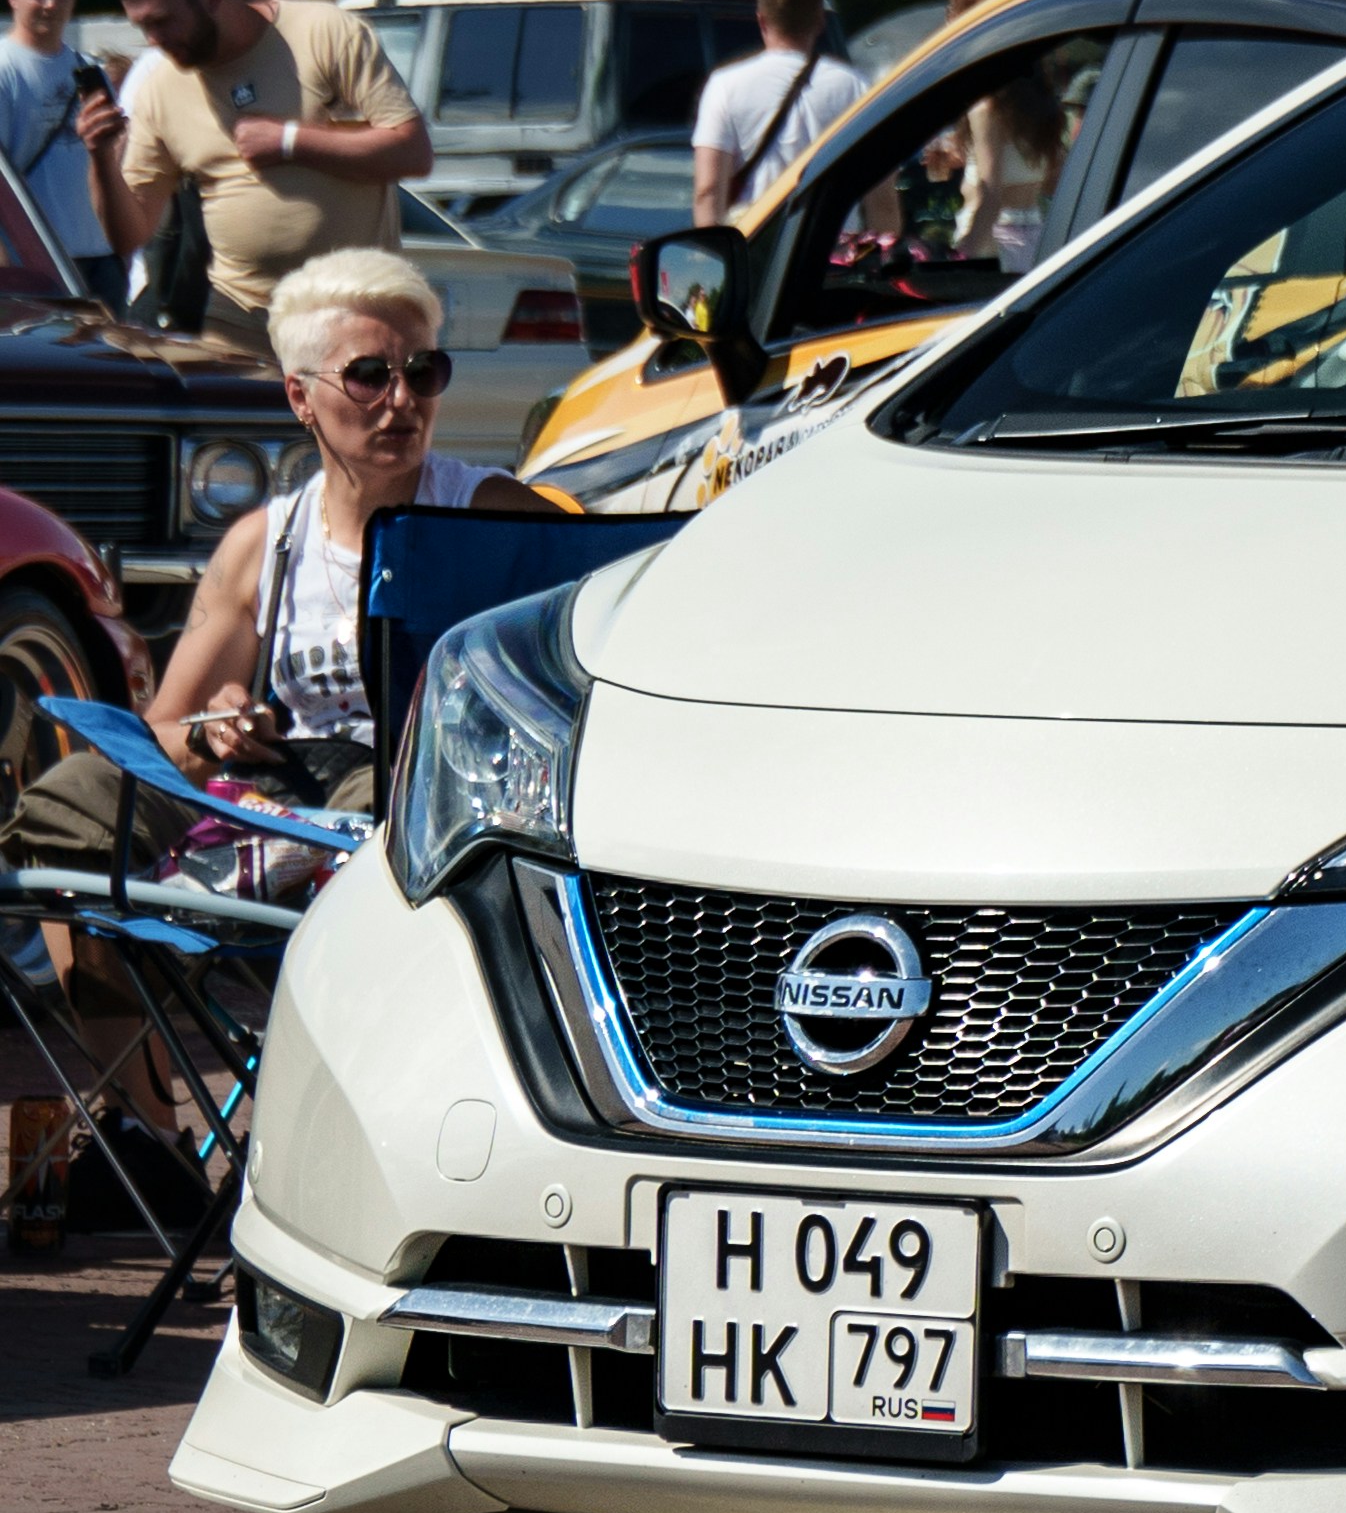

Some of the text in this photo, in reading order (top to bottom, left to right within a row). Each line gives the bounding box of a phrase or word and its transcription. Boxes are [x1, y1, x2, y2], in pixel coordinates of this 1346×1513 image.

[782, 982, 905, 1009] NISSAN
[795, 1213, 932, 1300] 049
[847, 1323, 955, 1392] 797
[871, 1395, 918, 1420] RUS
